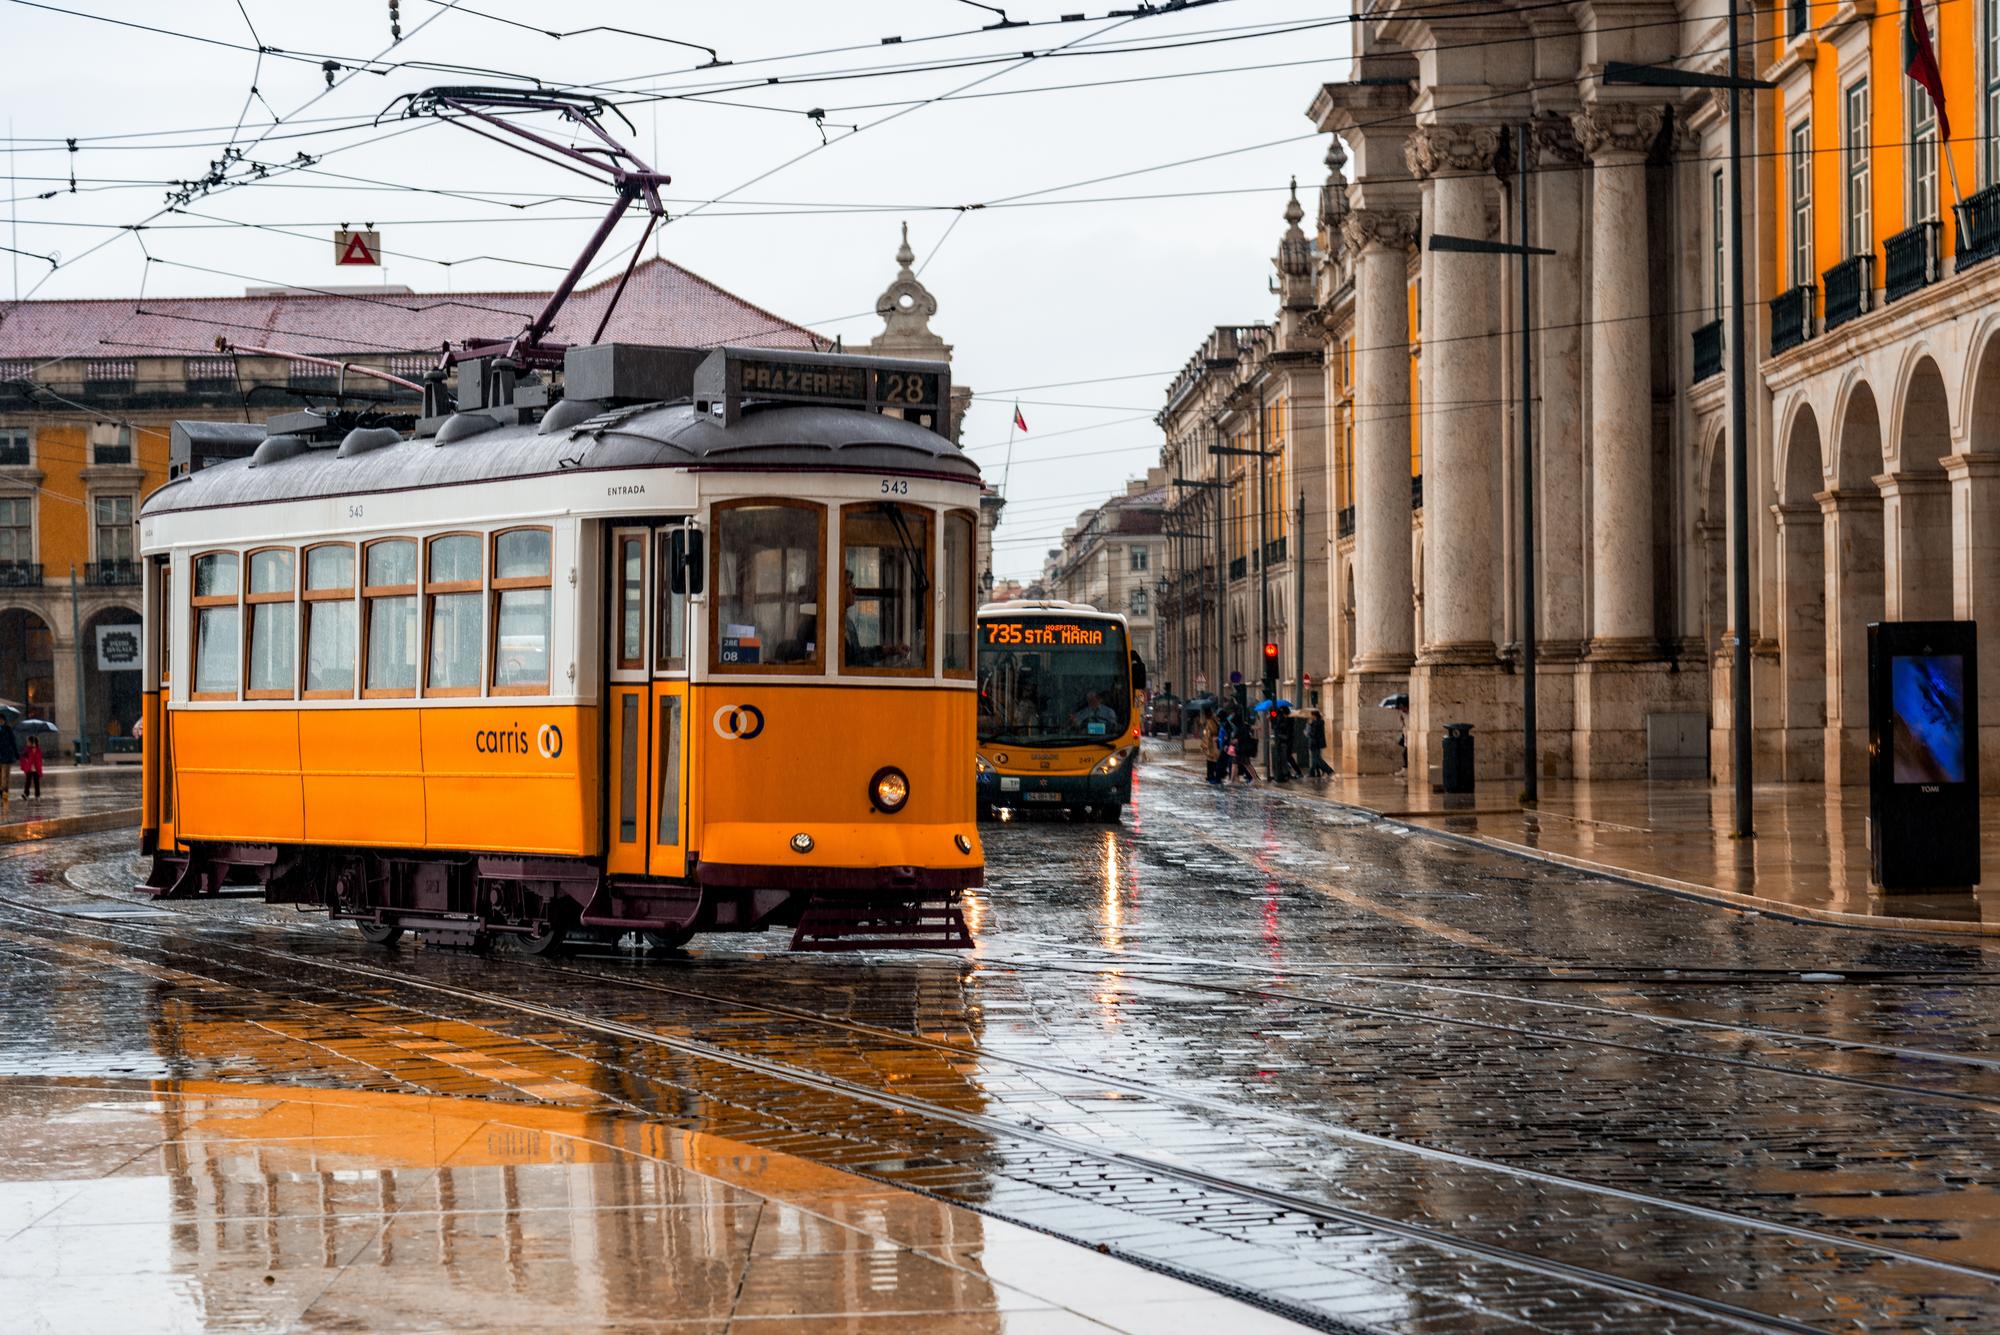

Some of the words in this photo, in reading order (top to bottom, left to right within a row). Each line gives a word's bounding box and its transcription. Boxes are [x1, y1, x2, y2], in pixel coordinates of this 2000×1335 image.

[742, 366, 856, 394] PRAZERES
[887, 374, 924, 404] 28
[607, 484, 646, 497] ENTRADA
[880, 479, 908, 495] 543
[349, 504, 364, 518] 543
[986, 623, 1022, 644] 735
[1024, 629, 1056, 644] STA.
[1061, 630, 1103, 644] MARIA
[723, 651, 738, 662] 08
[475, 721, 528, 754] carris
[1920, 785, 1940, 793] TOMI
